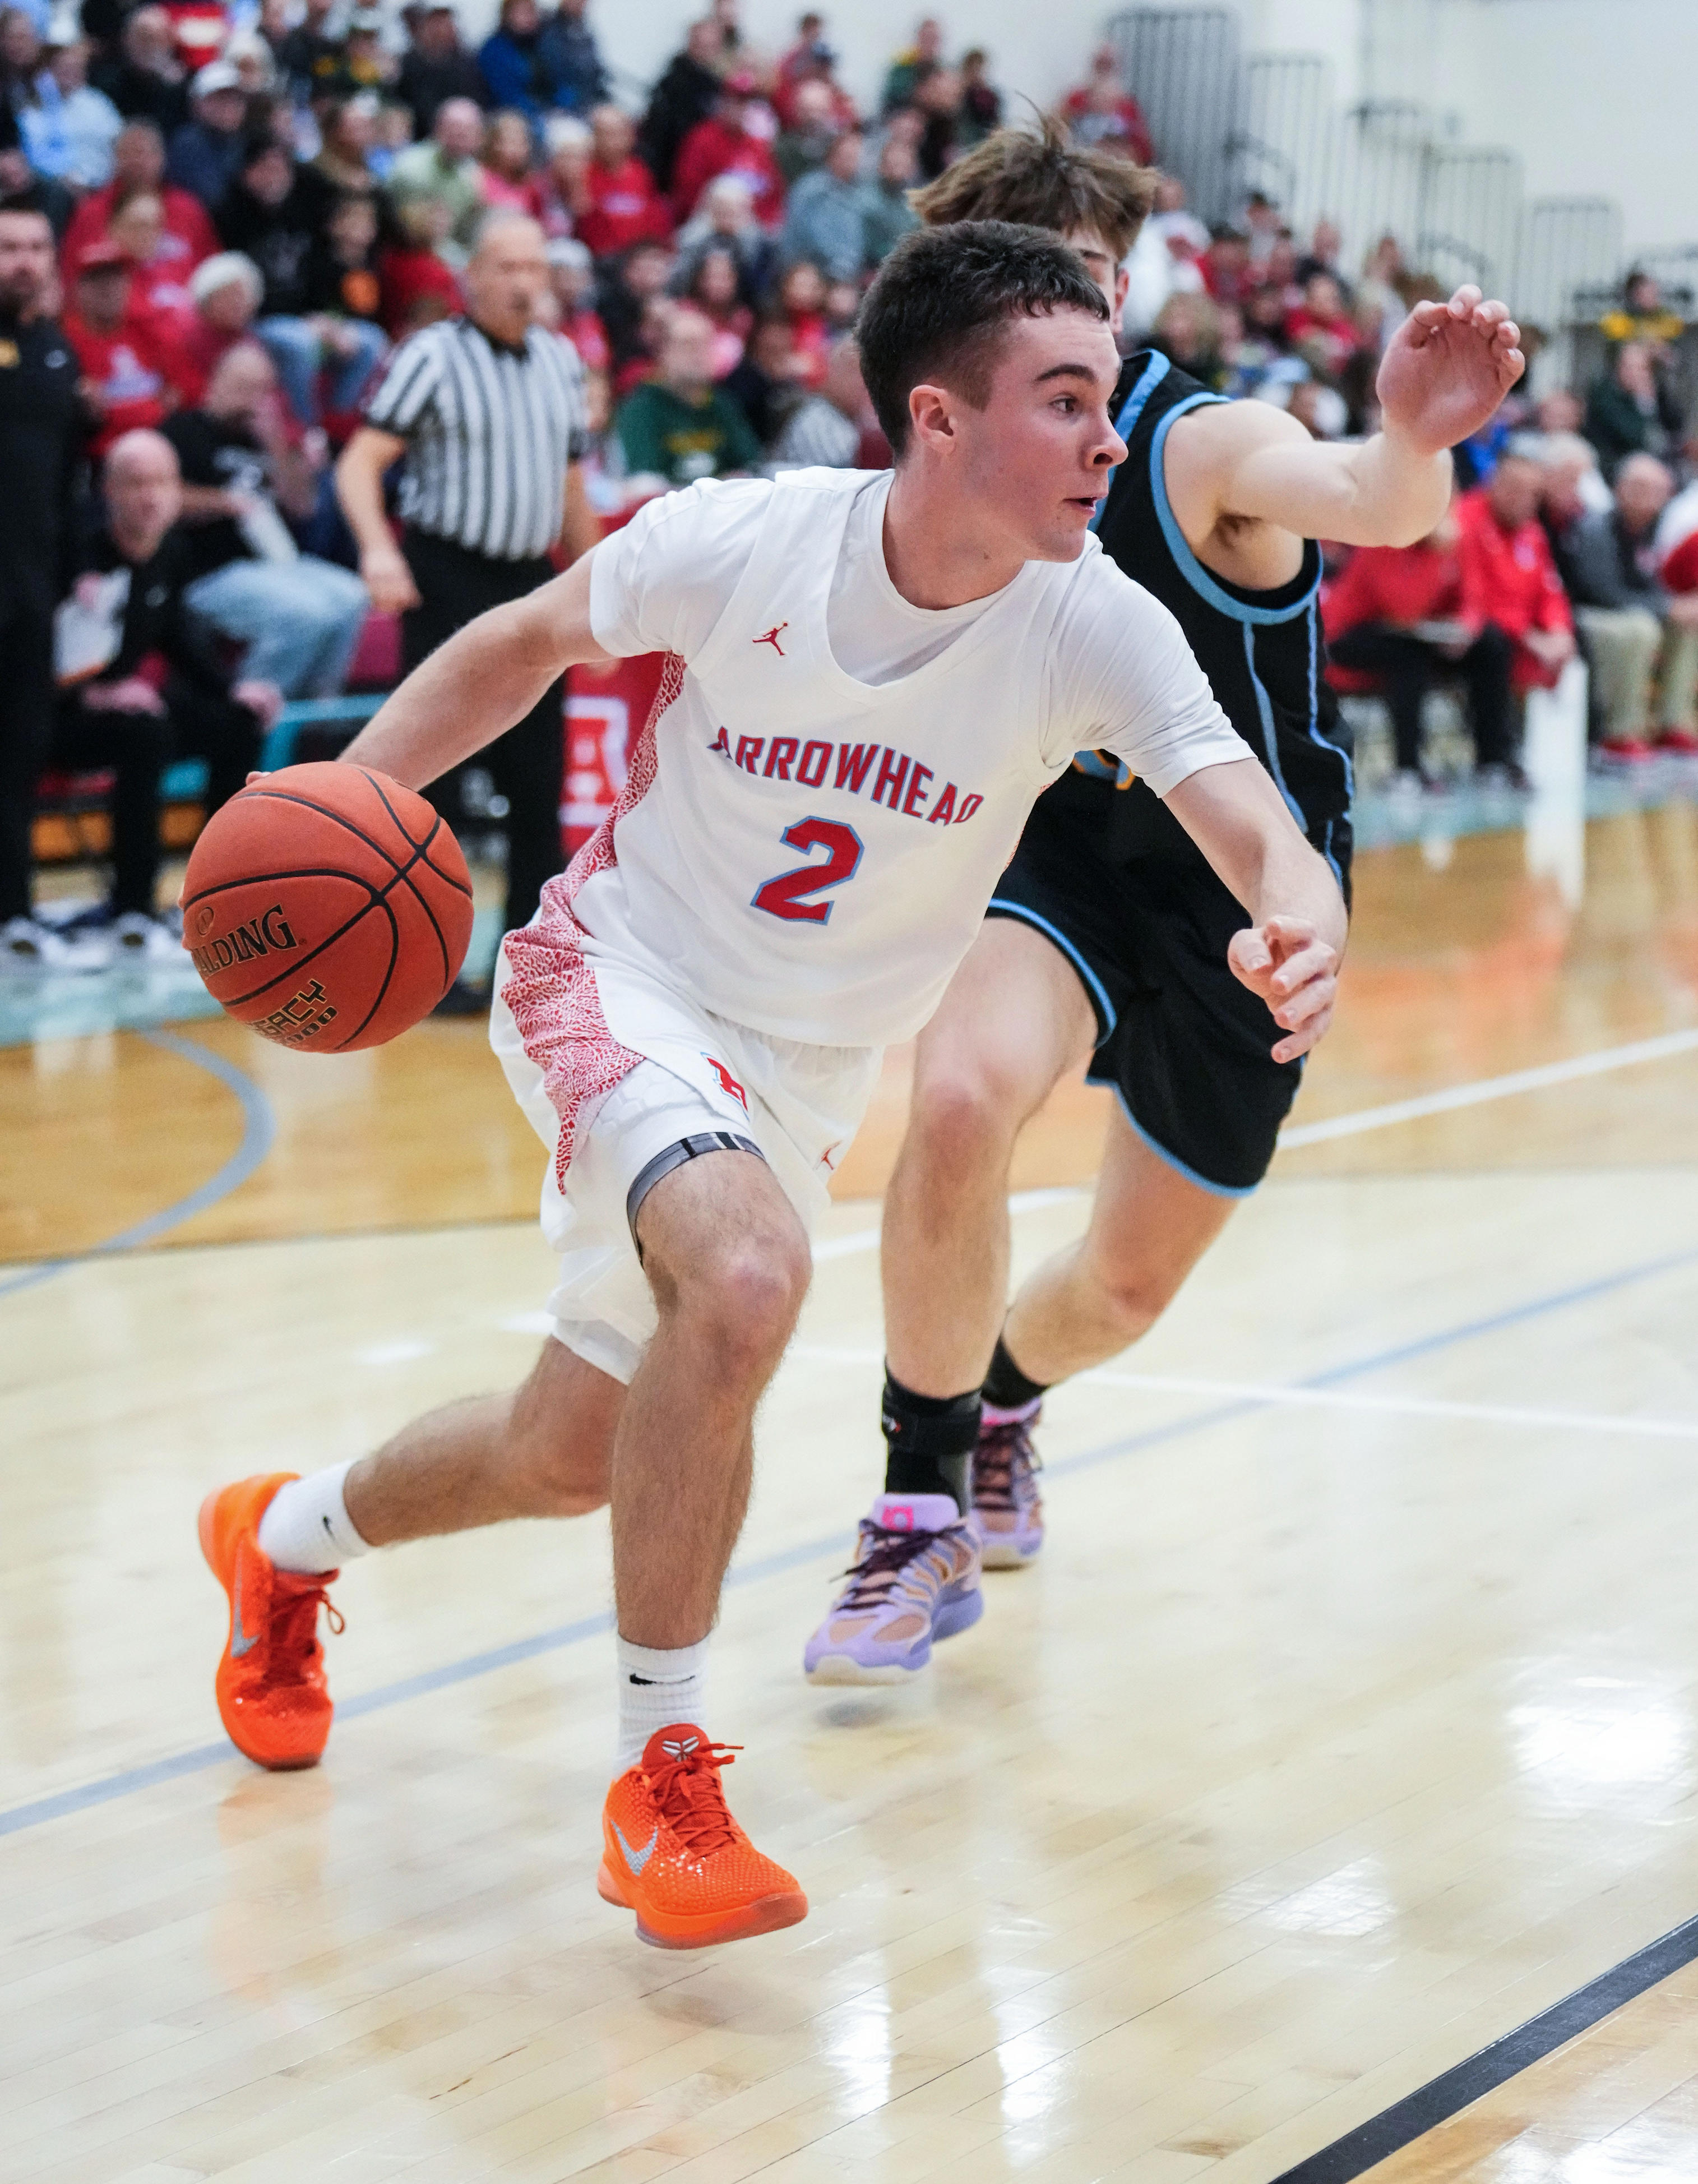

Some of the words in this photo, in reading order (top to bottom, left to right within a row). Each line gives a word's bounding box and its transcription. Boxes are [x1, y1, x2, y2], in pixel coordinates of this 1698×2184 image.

[706, 726, 984, 827] ARROWHEAD
[750, 815, 865, 926] 2
[191, 903, 299, 980] ALDING
